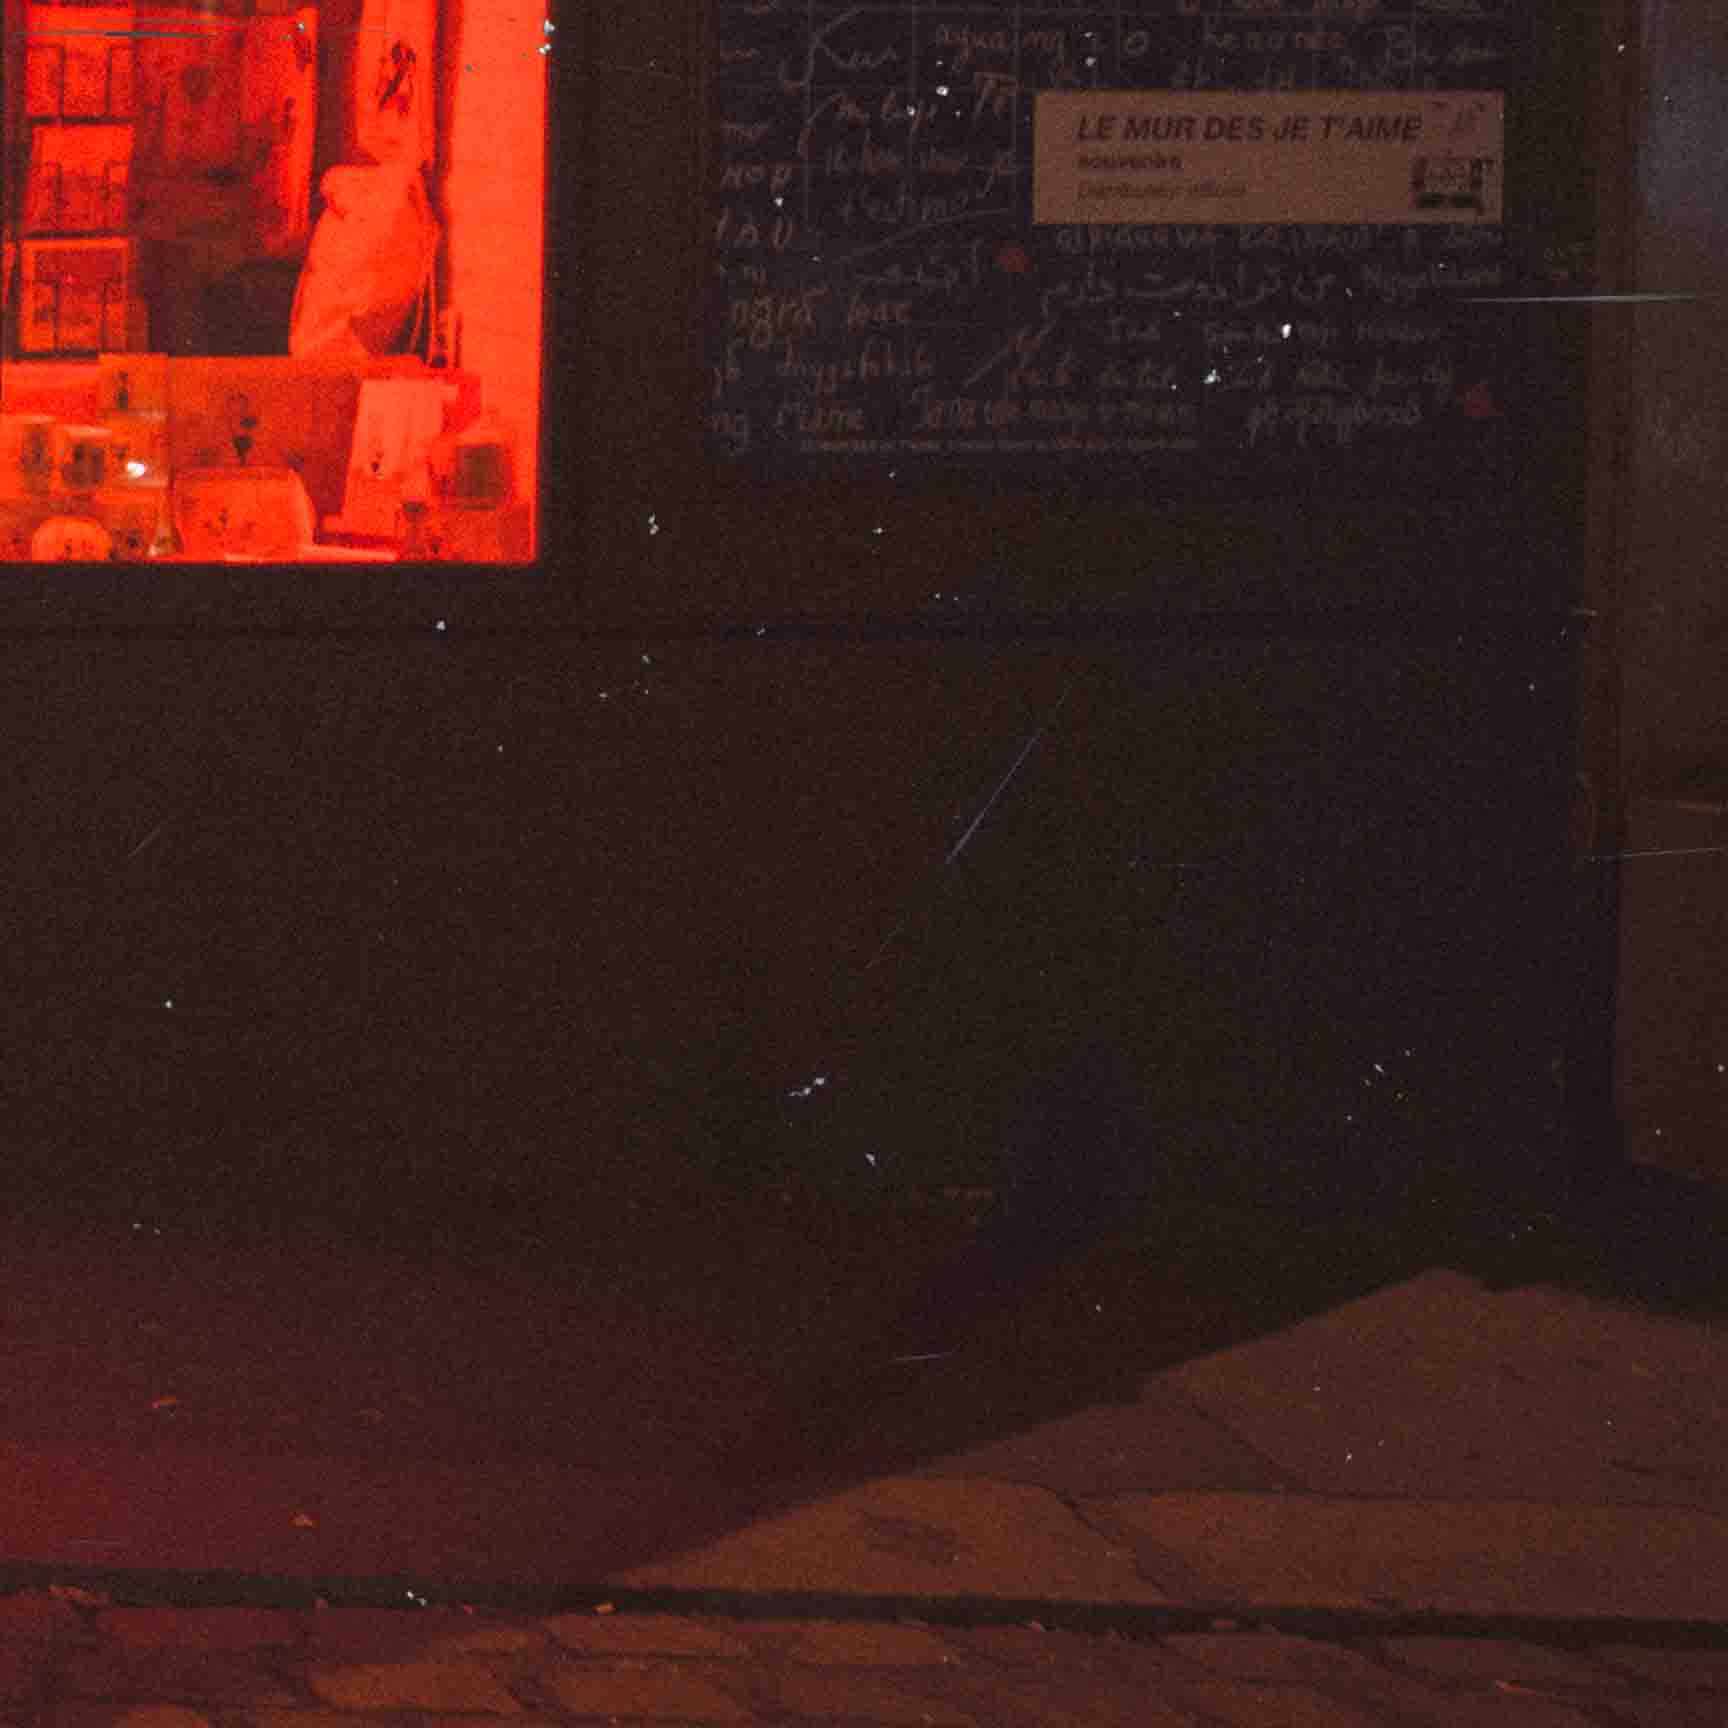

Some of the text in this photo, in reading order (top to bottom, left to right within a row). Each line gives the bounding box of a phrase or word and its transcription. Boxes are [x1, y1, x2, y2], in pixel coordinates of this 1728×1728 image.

[1077, 114, 1423, 142] LE MUR DES JE T'AIME
